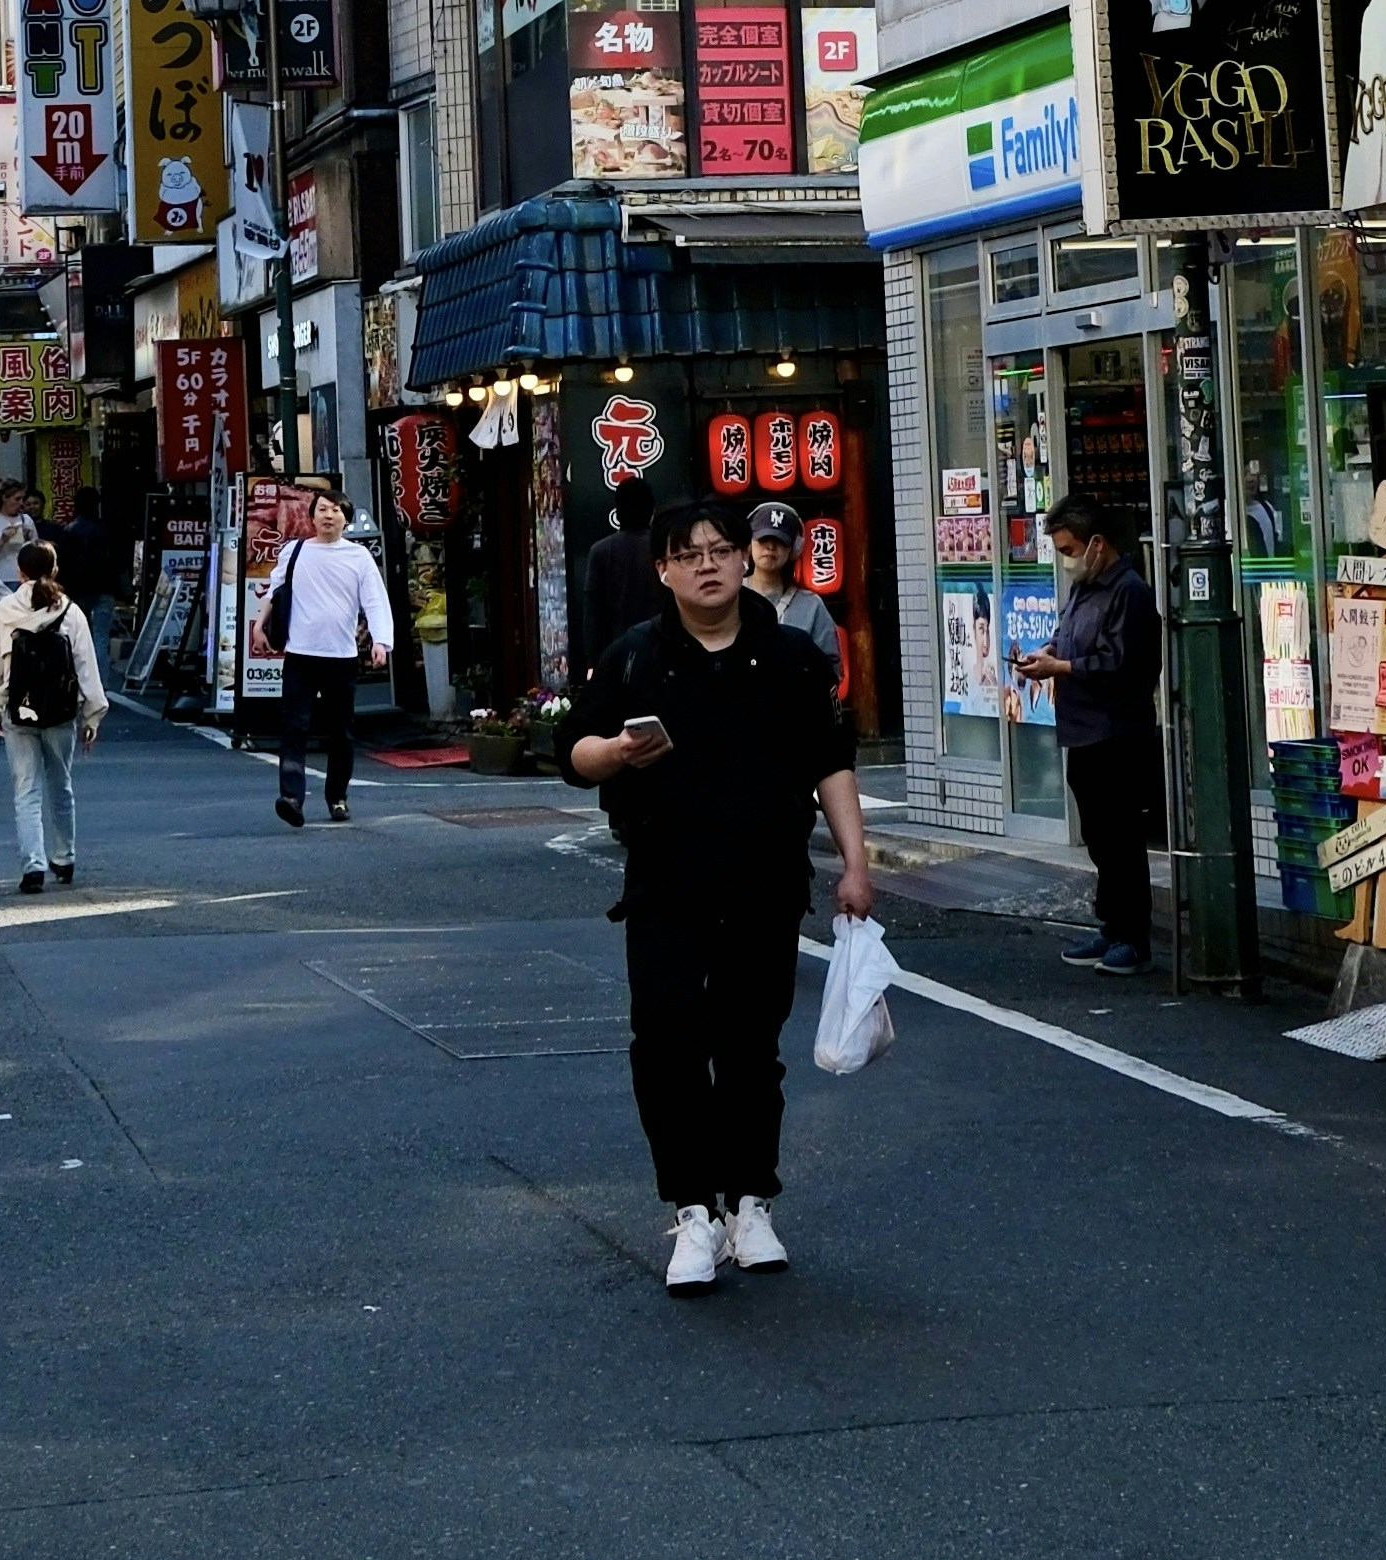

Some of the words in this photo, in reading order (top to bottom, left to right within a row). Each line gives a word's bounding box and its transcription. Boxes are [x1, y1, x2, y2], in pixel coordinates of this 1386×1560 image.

[293, 20, 316, 37] 2F
[594, 22, 654, 54] 名物
[698, 23, 781, 47] 完全個室
[823, 39, 850, 60] 2F
[698, 62, 781, 84] カップルシート
[701, 99, 785, 123] 貸切個室
[52, 110, 85, 139] 20
[56, 141, 81, 164] m
[53, 166, 85, 181] 手前
[176, 347, 202, 367] 5F
[720, 422, 747, 483] 焼肉
[769, 417, 794, 482] ホルモン
[807, 419, 834, 478] 焼肉
[173, 533, 205, 546] BAR
[810, 523, 837, 587] ホルモン
[1341, 737, 1377, 762] SMOKING
[1351, 756, 1371, 777] OK
